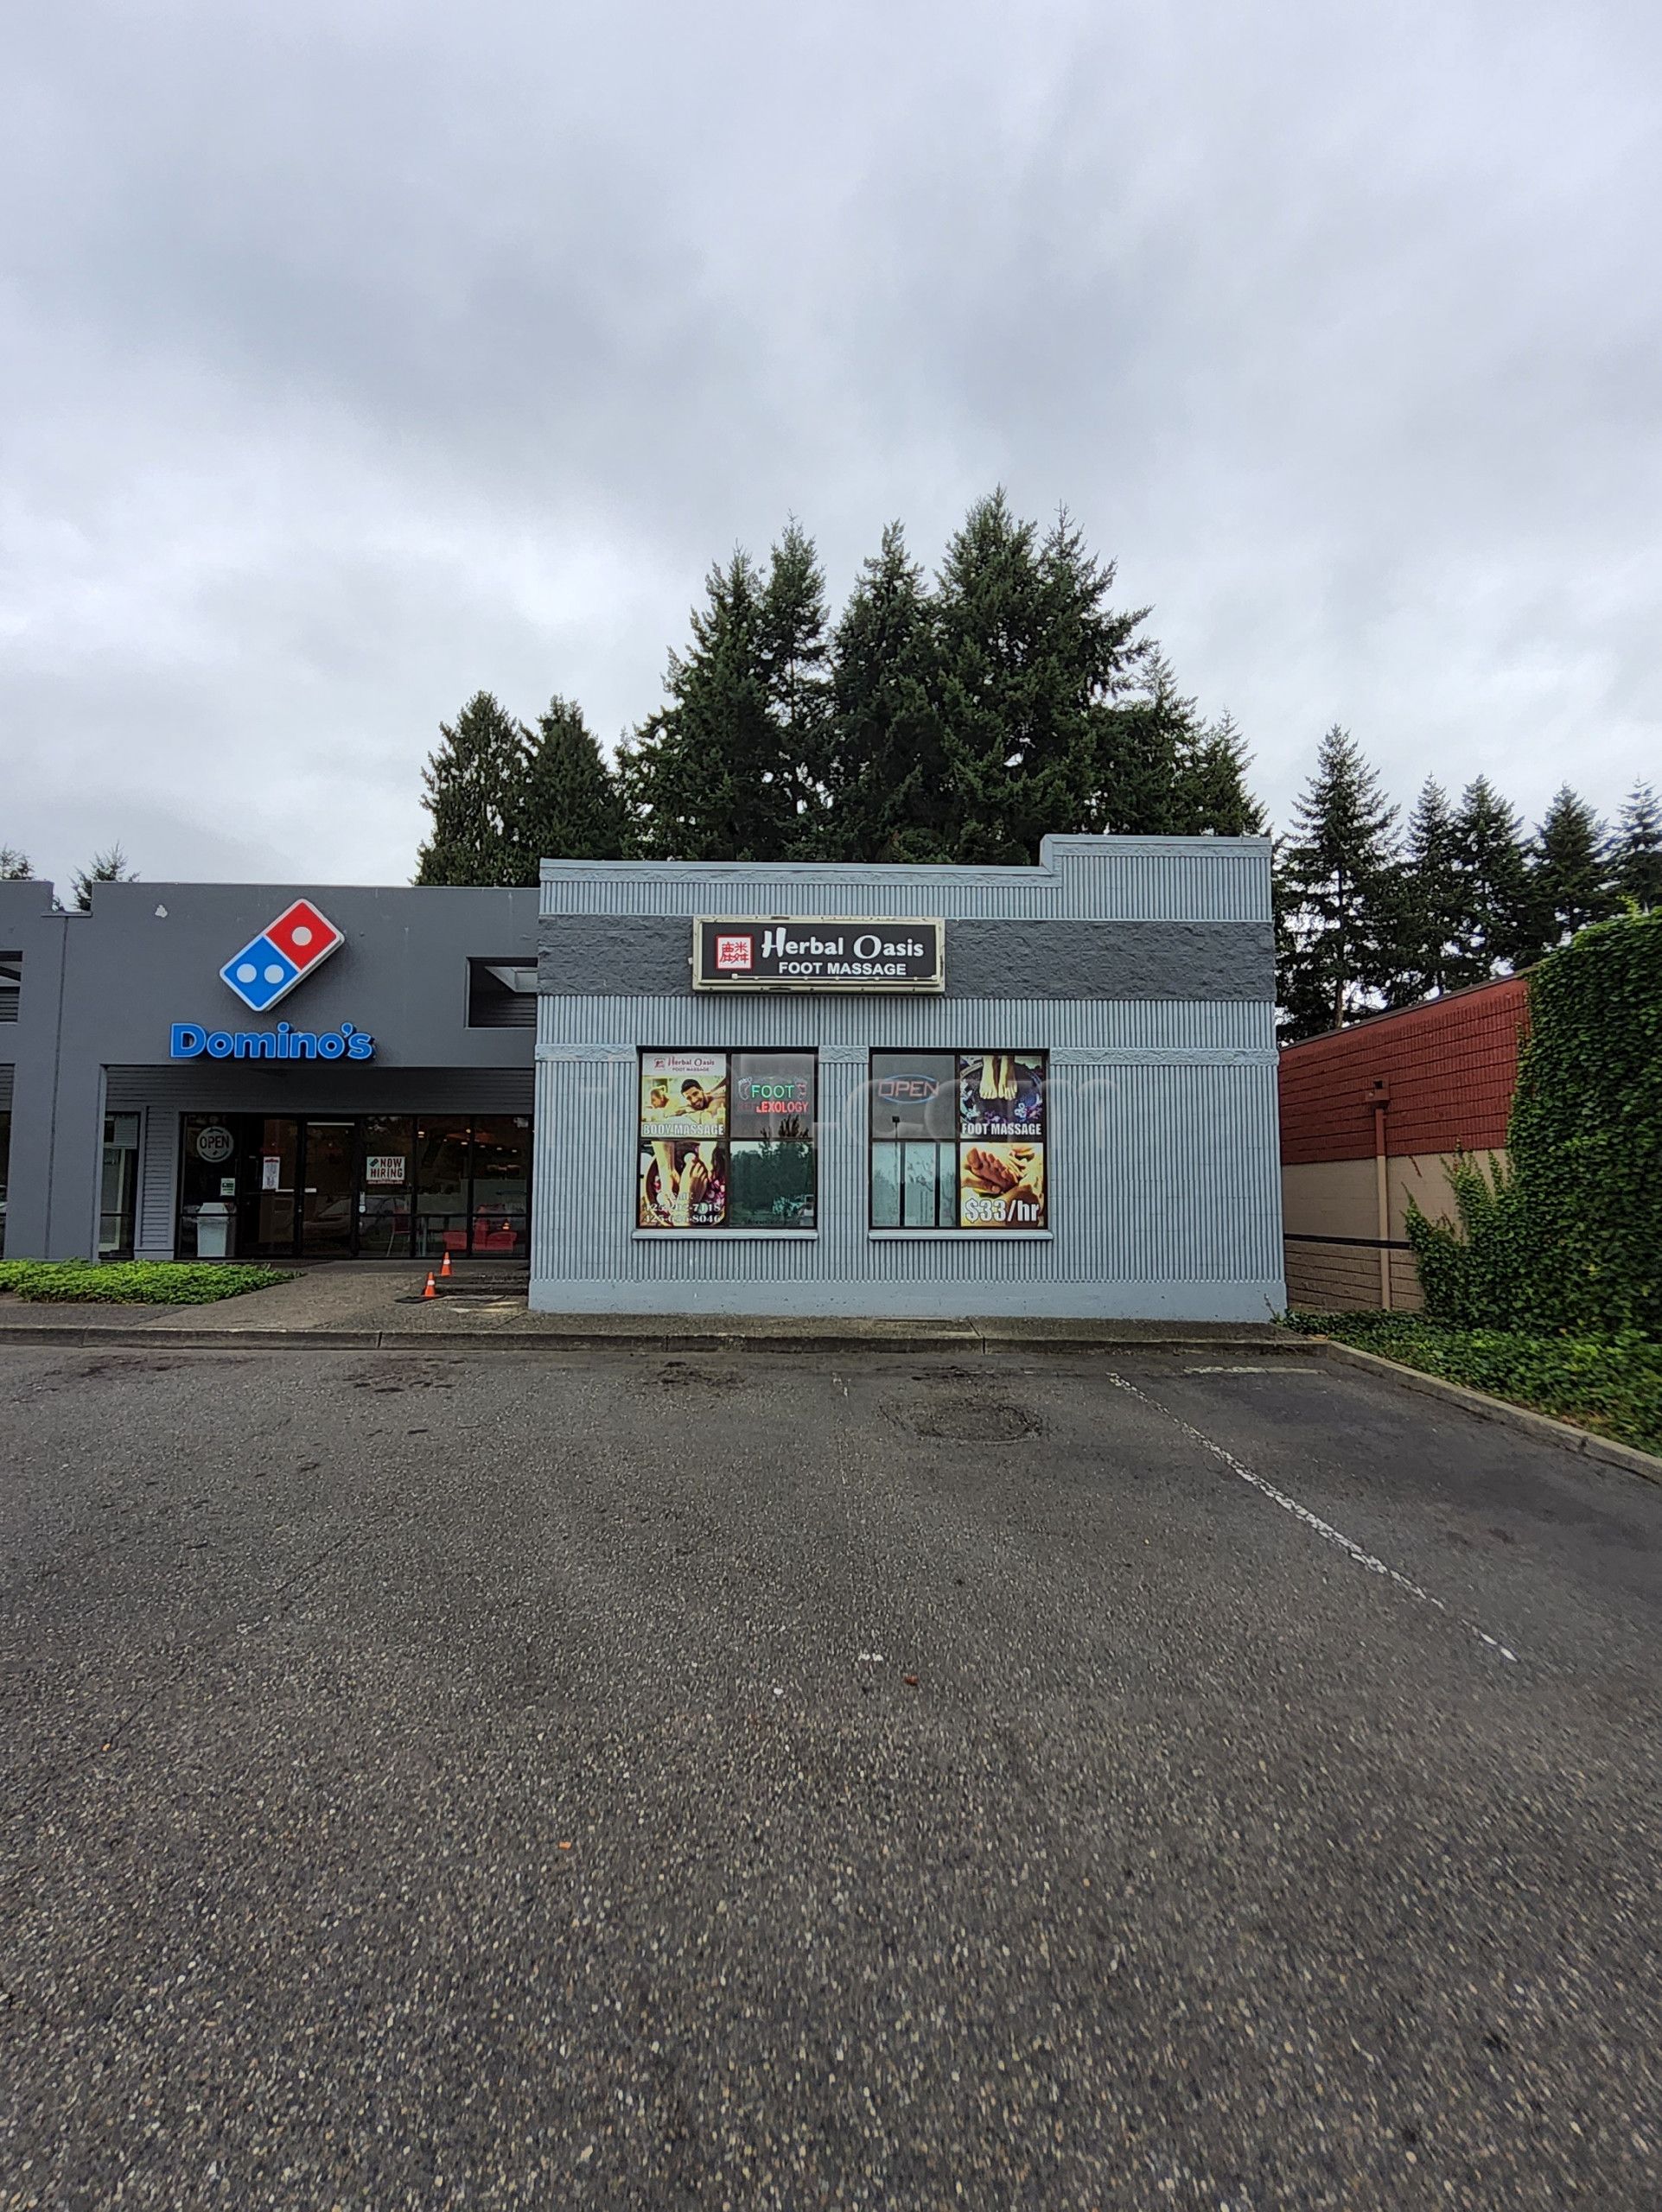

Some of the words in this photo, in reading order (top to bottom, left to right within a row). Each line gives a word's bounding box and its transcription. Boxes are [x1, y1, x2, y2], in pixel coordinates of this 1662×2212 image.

[761, 927, 844, 958] Herbal
[853, 935, 924, 959] Oasis
[779, 962, 823, 975] FOOT
[827, 963, 907, 976] MASSAGE
[171, 1022, 373, 1059] Domino's
[668, 1056, 691, 1066] Herbal
[694, 1058, 715, 1067] Oasis
[751, 1084, 795, 1098] FOOT
[878, 1081, 939, 1096] OPEN
[643, 1124, 672, 1135] BODY
[674, 1124, 724, 1135] MASSAGE
[962, 1123, 987, 1135] FOOT
[991, 1123, 1042, 1135] MASSAGE
[200, 1135, 230, 1149] OPEN
[380, 1158, 402, 1167] NOW
[371, 1168, 403, 1178] HIRING
[965, 1198, 1040, 1224] $33/hr
